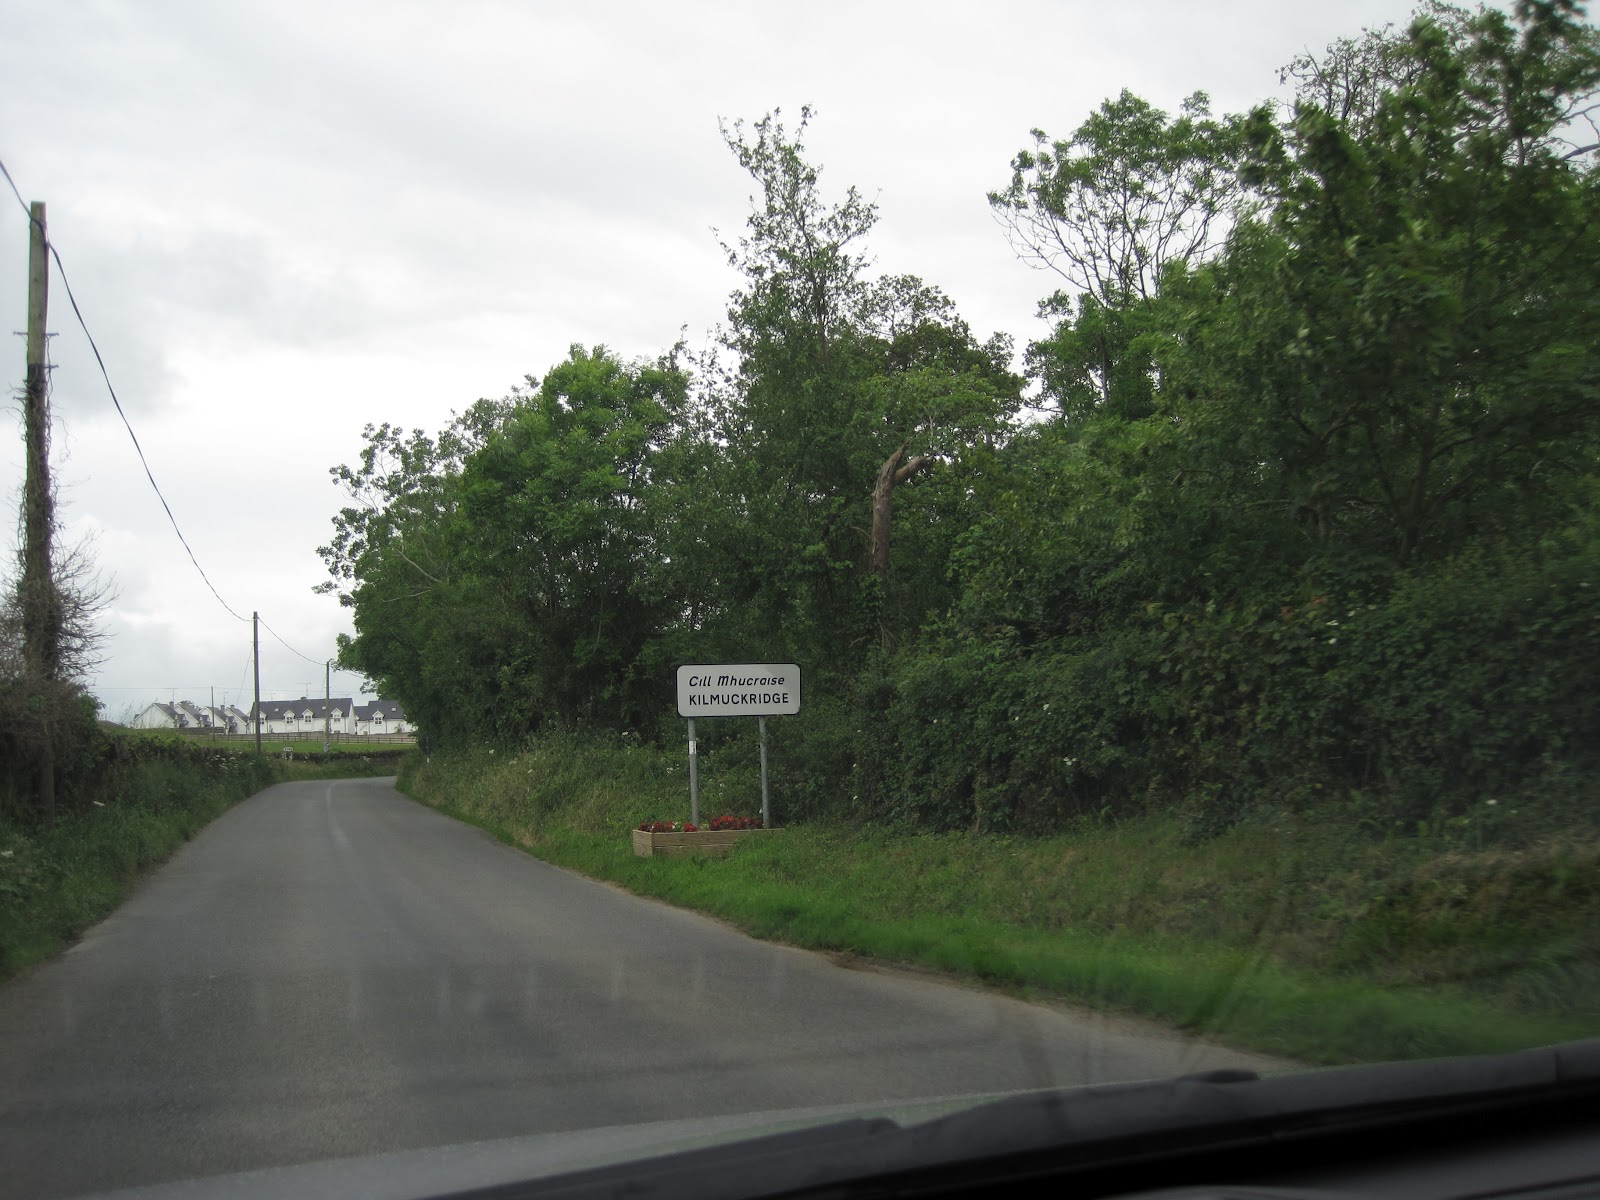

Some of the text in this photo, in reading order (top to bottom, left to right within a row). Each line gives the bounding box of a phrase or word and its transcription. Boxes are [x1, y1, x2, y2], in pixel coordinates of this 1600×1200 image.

[689, 675, 785, 687] Cill Mhucraise
[689, 693, 789, 705] KILMUCKRIDGE
